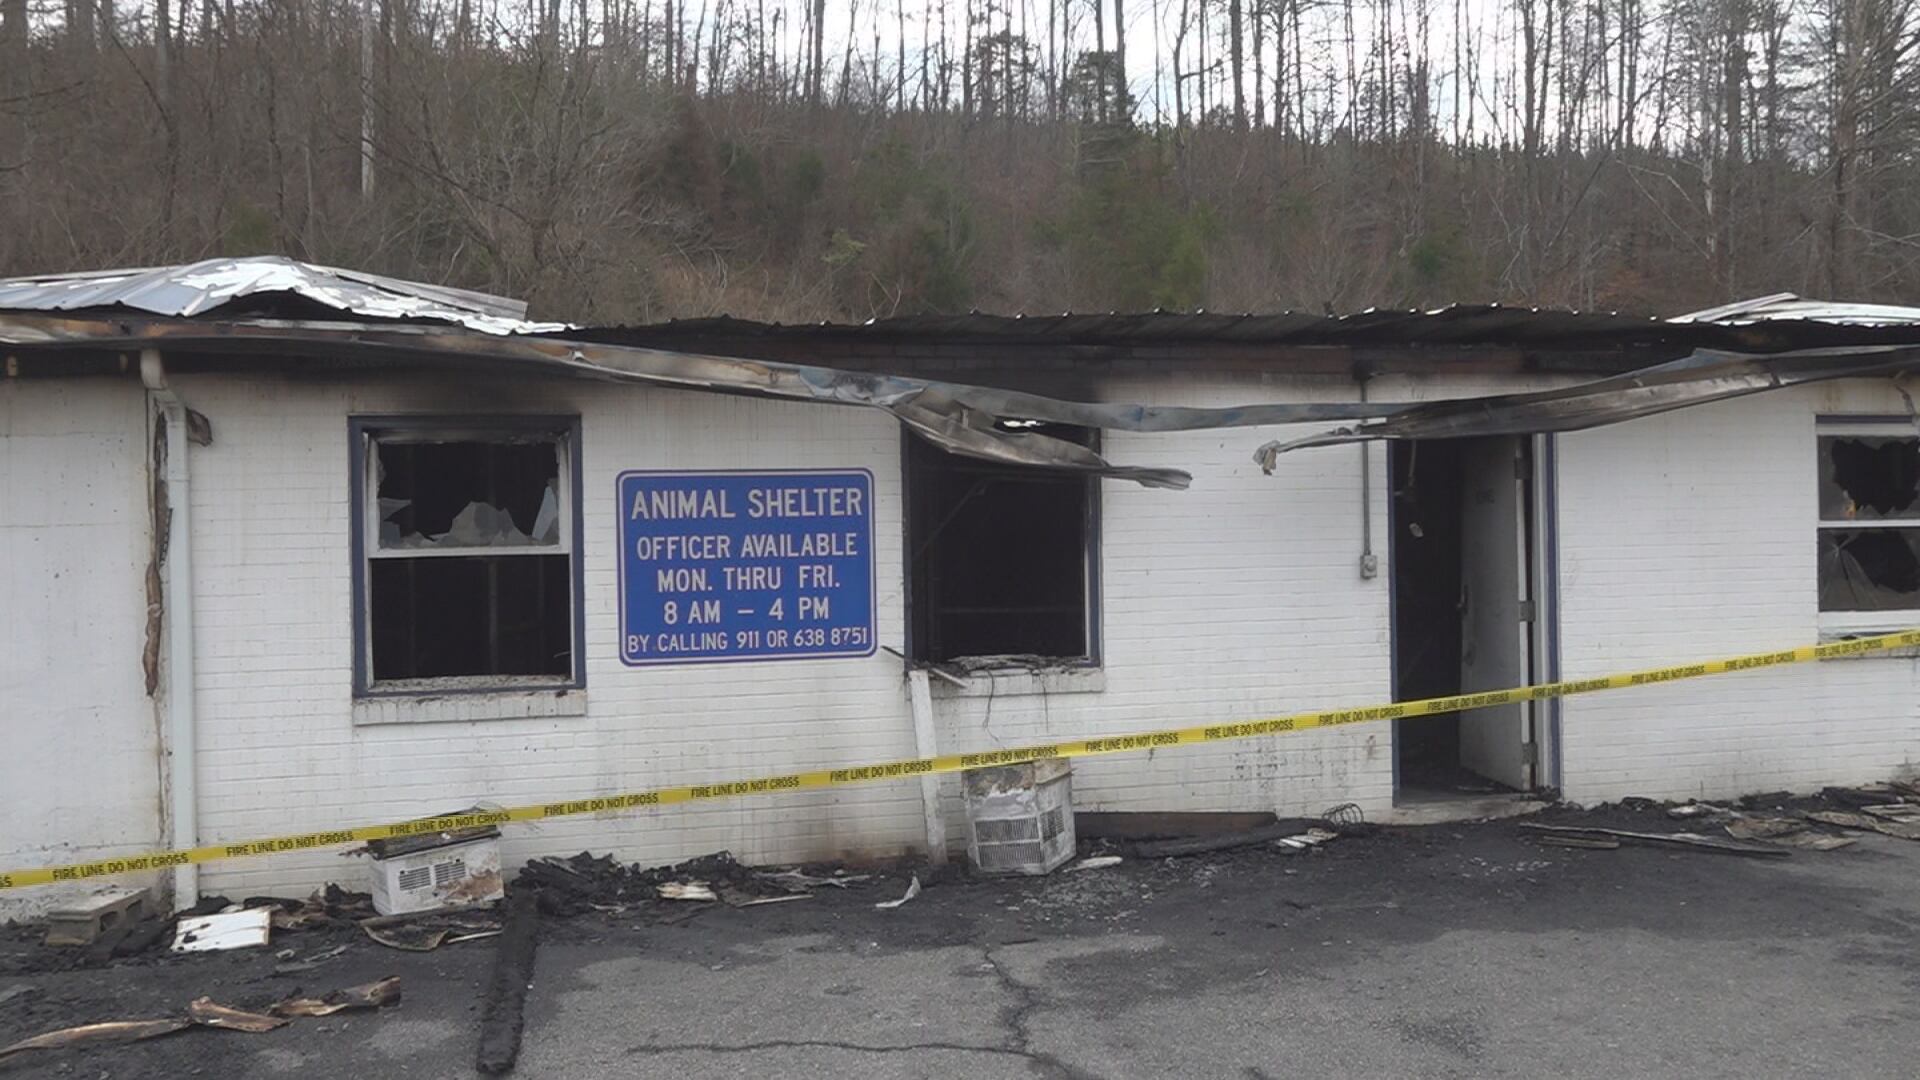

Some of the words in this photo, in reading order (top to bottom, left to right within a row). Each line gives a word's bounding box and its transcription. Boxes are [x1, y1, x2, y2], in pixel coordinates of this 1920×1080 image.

[631, 489, 736, 520] ANIMAL
[748, 488, 863, 517] SHELTER
[636, 535, 731, 560] OFFICER
[740, 533, 858, 557] AVAILABLE
[658, 568, 713, 593] MON.
[723, 566, 781, 590] THRU
[799, 565, 840, 589] FRI.
[663, 601, 678, 625] 8
[688, 600, 721, 624] AM
[768, 598, 784, 620] 4
[799, 596, 829, 620] PM
[628, 634, 649, 653] BY
[658, 632, 728, 651] CALLING
[736, 630, 760, 648] 911
[767, 629, 788, 648] OR
[794, 629, 825, 646] 638
[831, 627, 867, 645] 8751
[1428, 702, 1442, 712] FIRE
[1444, 699, 1457, 710] LINE
[1460, 698, 1470, 707] DO
[1472, 696, 1485, 705] NOT
[1486, 692, 1509, 703] CROSS
[1319, 714, 1333, 725] FIRE
[1336, 712, 1350, 723] LINE
[1353, 711, 1362, 721] DO
[1365, 709, 1378, 720] NOT
[1380, 706, 1403, 717] CROSS
[1205, 728, 1220, 739] FIRE
[1223, 726, 1239, 737] LINE
[1241, 725, 1251, 735] DO
[1253, 722, 1268, 733] NOT
[1269, 720, 1293, 732] CROSS
[1085, 742, 1102, 752] FIRE
[1104, 739, 1121, 750] LINE
[1123, 738, 1133, 748] DO
[1136, 735, 1151, 747] NOT
[1153, 732, 1178, 745] CROSS
[961, 755, 978, 767] FIRE
[981, 753, 997, 764] LINE
[1002, 752, 1012, 761] DO
[1014, 750, 1030, 760] NOT
[1032, 747, 1058, 758] CROSS
[830, 770, 848, 782] FIRE
[851, 768, 868, 780] LINE
[872, 767, 883, 777] DO
[886, 764, 902, 776] NOT
[904, 761, 932, 773] CROSS
[691, 787, 710, 798] FIRE
[713, 784, 732, 795] LINE
[736, 783, 748, 792] DO
[750, 780, 768, 791] NOT
[769, 776, 799, 788] CROSS
[544, 805, 565, 816] FIRE
[568, 802, 588, 813] LINE
[591, 799, 605, 810] DO
[607, 797, 626, 808] NOT
[628, 793, 658, 805] CROSS
[390, 823, 411, 835] FIRE
[415, 820, 436, 833] LINE
[439, 818, 452, 828] DO
[456, 816, 474, 826] NOT
[477, 812, 510, 824] CROSS
[227, 844, 250, 857] FIRE
[252, 841, 276, 853] LINE
[279, 839, 293, 850] DO
[296, 836, 316, 848] NOT
[319, 832, 353, 845] CROSS
[53, 868, 78, 880] FIRE
[80, 864, 103, 878] LINE
[108, 862, 125, 873] DO
[128, 860, 149, 871] NOT
[152, 853, 188, 867] CROSS
